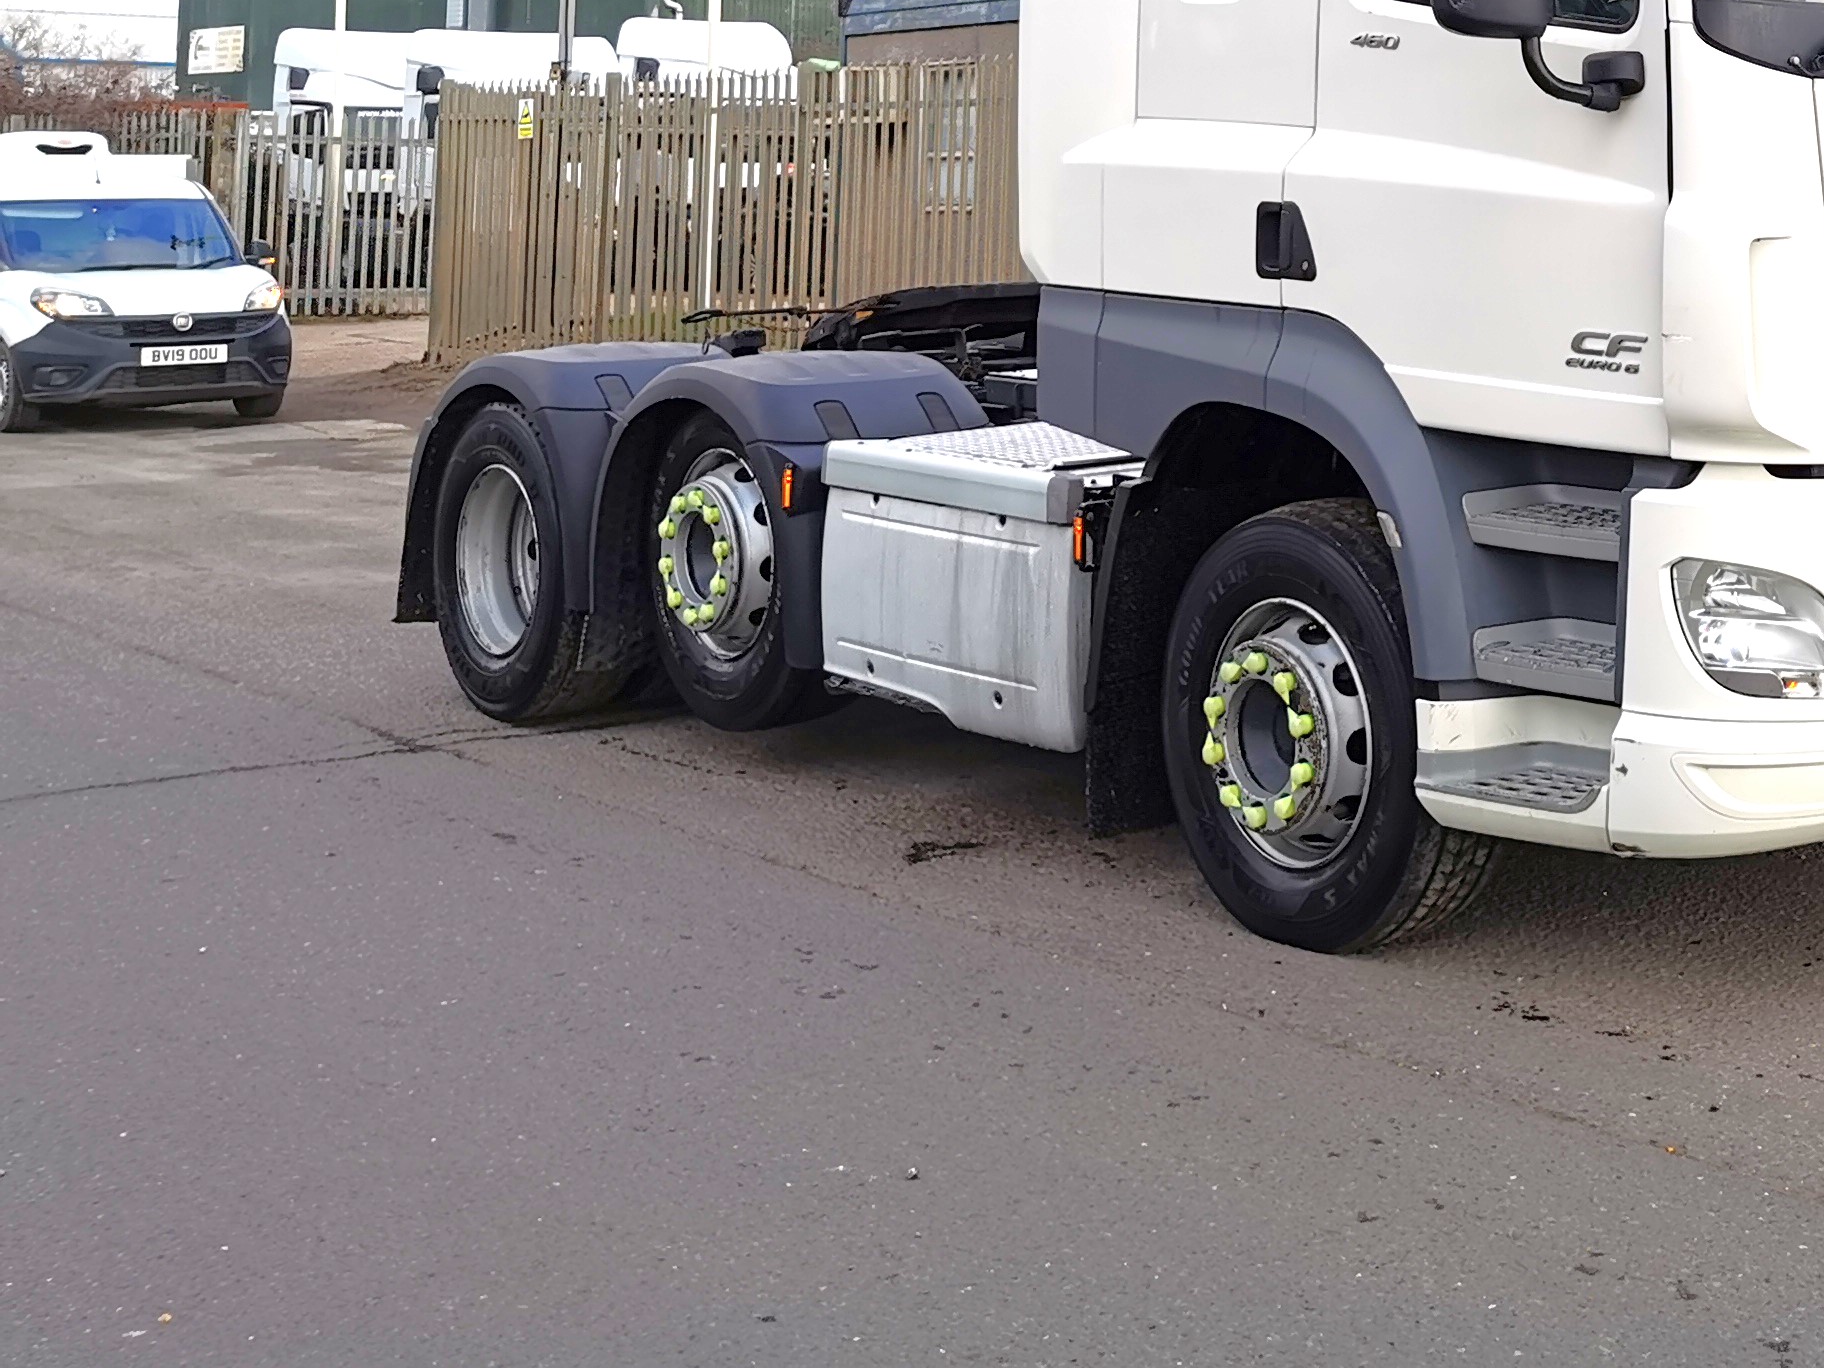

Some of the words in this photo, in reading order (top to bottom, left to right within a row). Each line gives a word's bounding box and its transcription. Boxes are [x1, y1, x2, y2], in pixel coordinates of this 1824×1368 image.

[1349, 33, 1401, 51] 460
[1570, 330, 1649, 358] CF
[151, 348, 185, 363] BV19
[1623, 363, 1641, 375] 6
